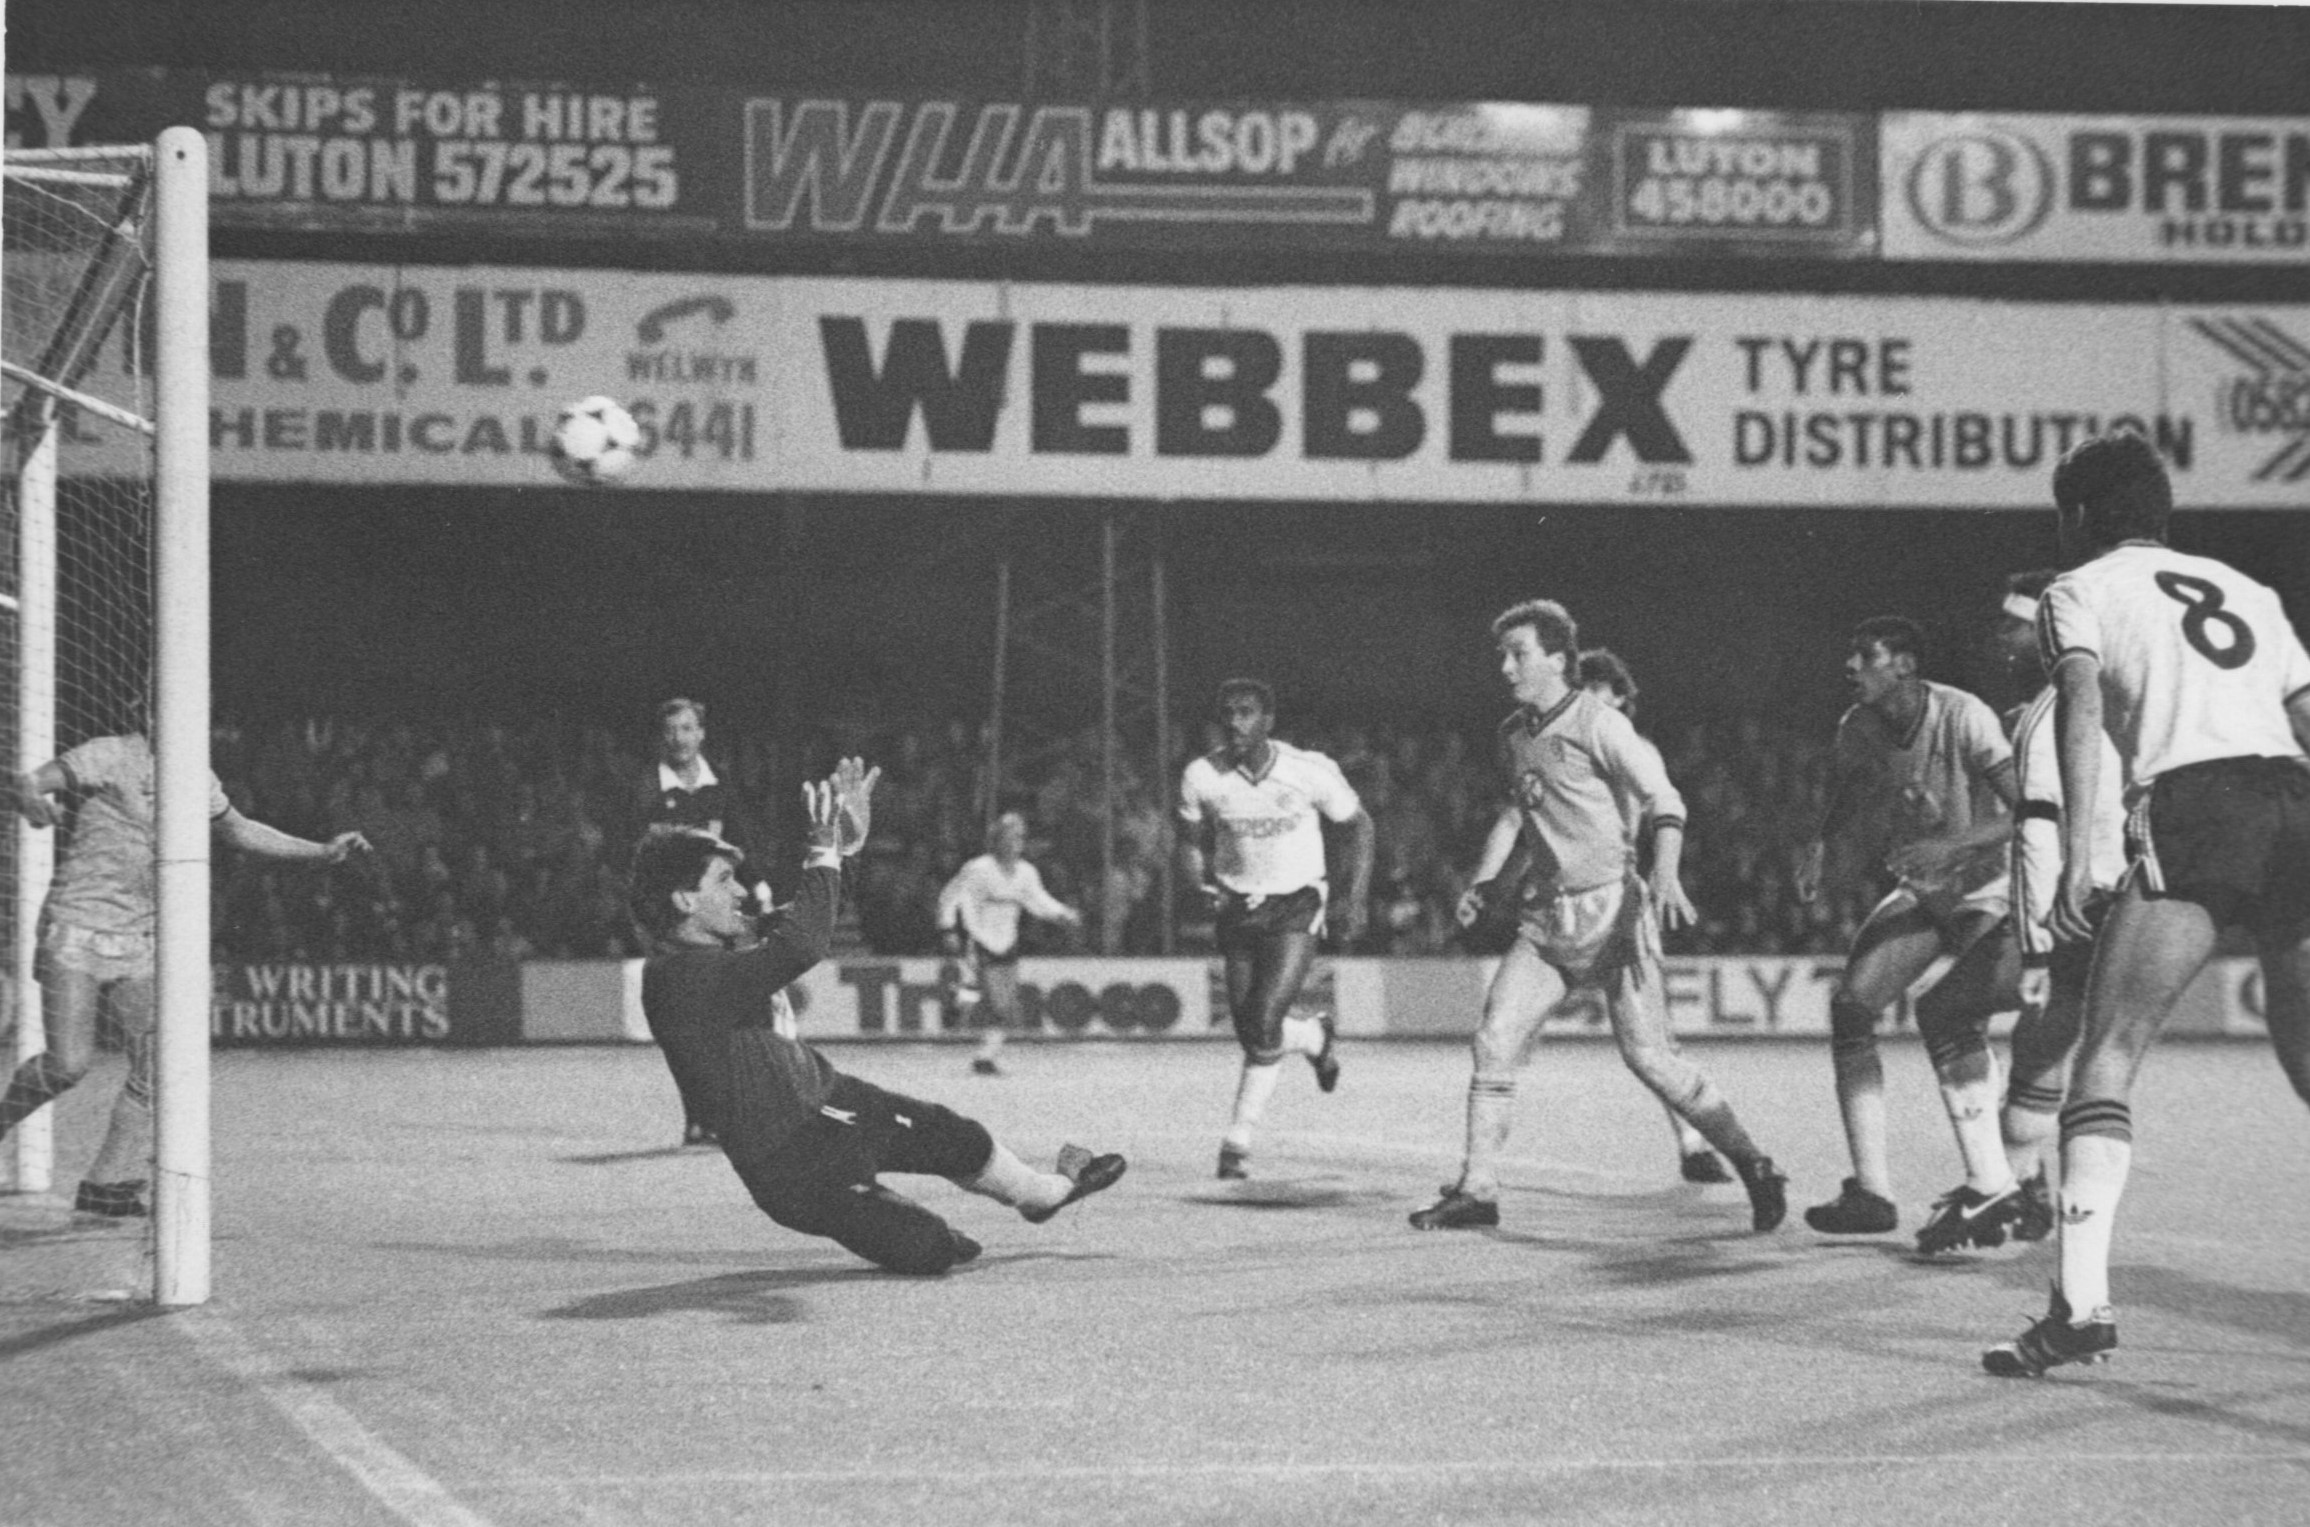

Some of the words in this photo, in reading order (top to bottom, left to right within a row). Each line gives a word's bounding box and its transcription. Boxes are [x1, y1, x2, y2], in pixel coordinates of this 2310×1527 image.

[205, 83, 376, 134] SKIPS
[401, 91, 503, 139] FOR
[523, 94, 660, 142] HIRE
[1099, 109, 1318, 174] ALLSOP
[208, 134, 417, 199] LUTON
[434, 143, 679, 208] 572525
[1648, 139, 1821, 177] LUTON
[266, 322, 307, 382] &
[1736, 336, 1912, 396] TYRE
[818, 314, 1696, 465] WEBBEX
[208, 407, 549, 456] HEMICAL
[2153, 569, 2256, 670] 8
[245, 962, 448, 1001] WRITING
[209, 1000, 450, 1039] TRUMENTS
